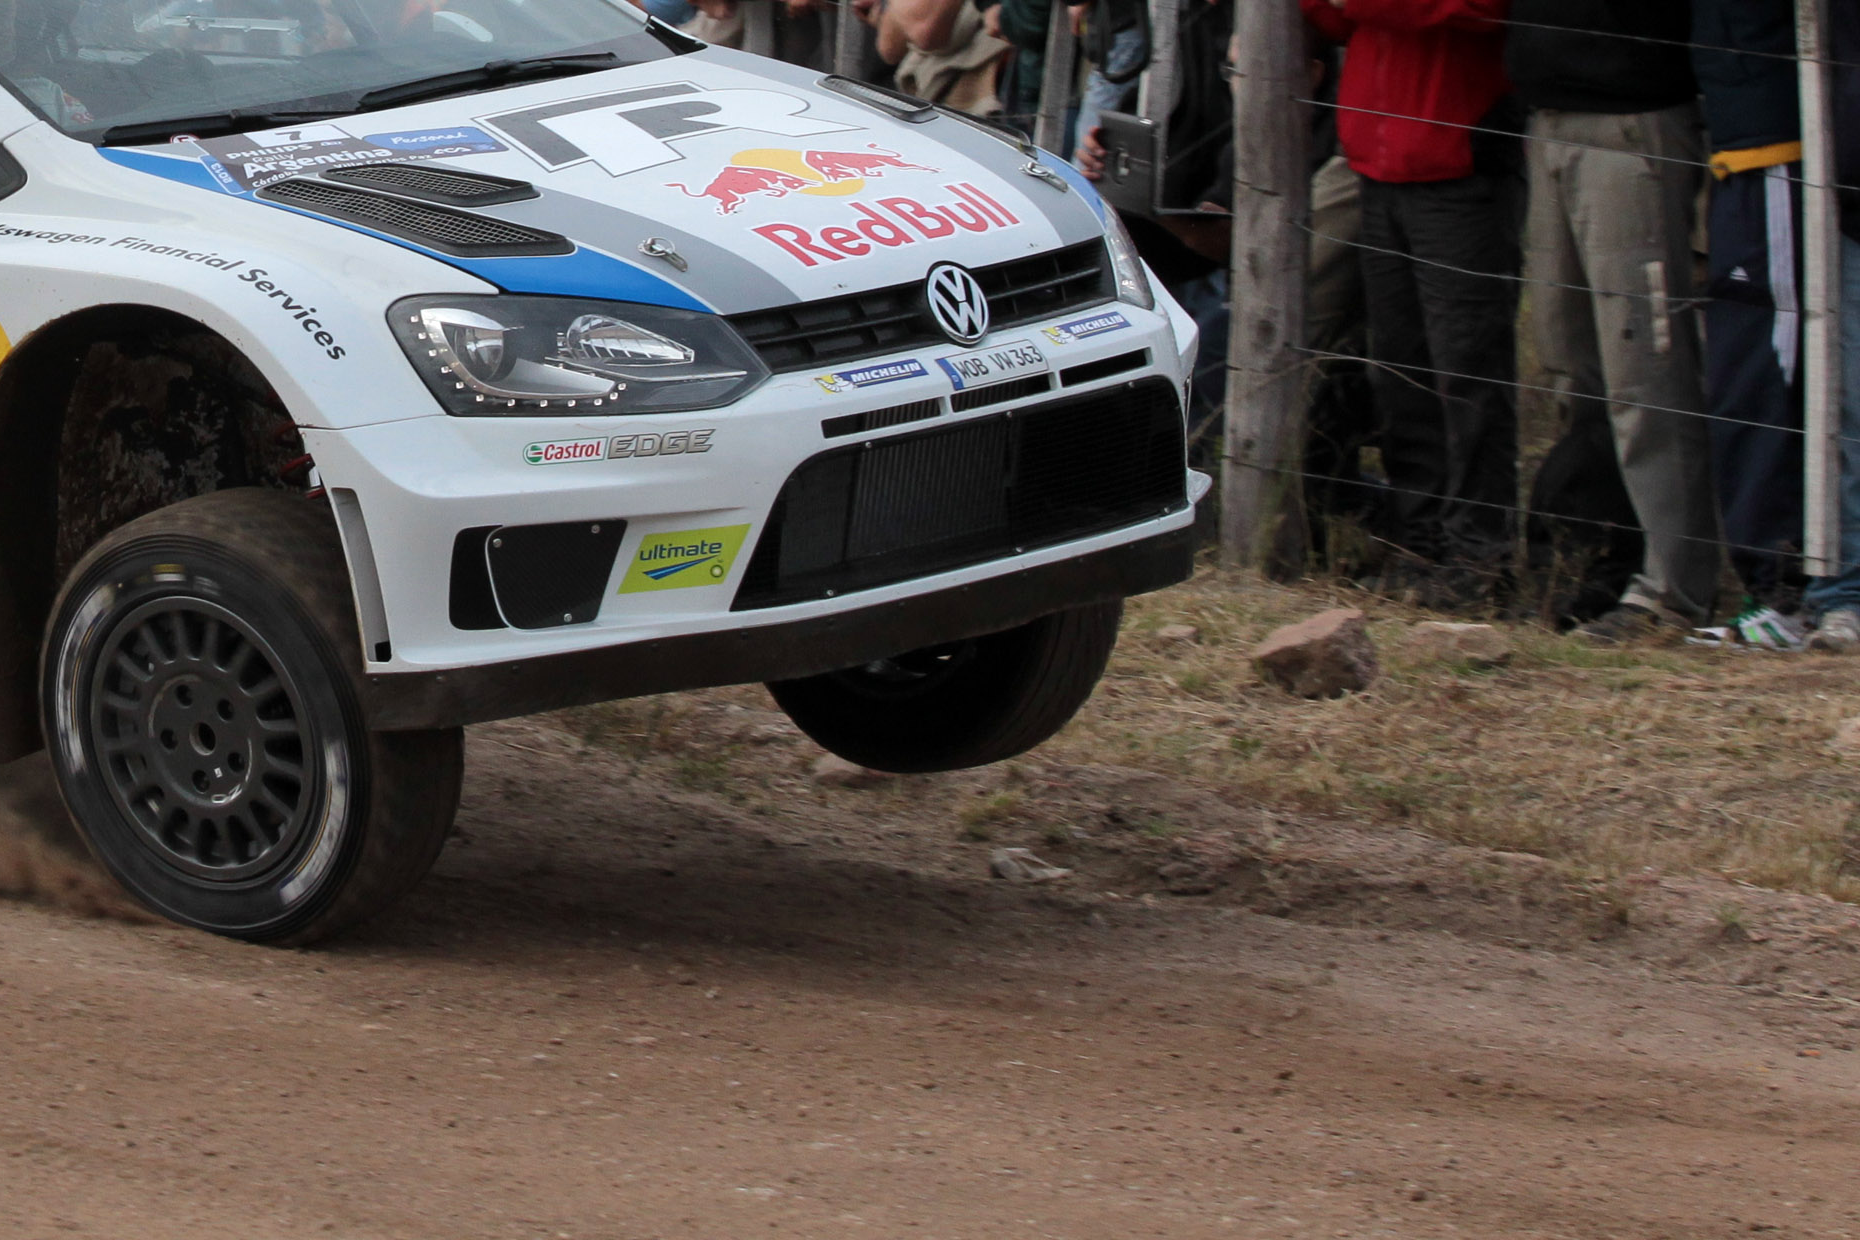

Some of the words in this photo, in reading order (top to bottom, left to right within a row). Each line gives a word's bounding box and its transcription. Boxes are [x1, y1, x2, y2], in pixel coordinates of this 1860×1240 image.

[274, 131, 302, 141] 7
[225, 144, 313, 159] PHILIPS
[252, 153, 294, 164] Rally
[243, 148, 393, 179] Argentina
[109, 236, 246, 272] Financial
[237, 268, 348, 361] Services
[1070, 314, 1123, 334] MICHELIN
[850, 362, 921, 383] MICHELIN
[952, 358, 989, 379] WOB
[544, 441, 601, 461] Castrol
[607, 428, 716, 460] EDGE
[640, 539, 723, 561] ultimate
